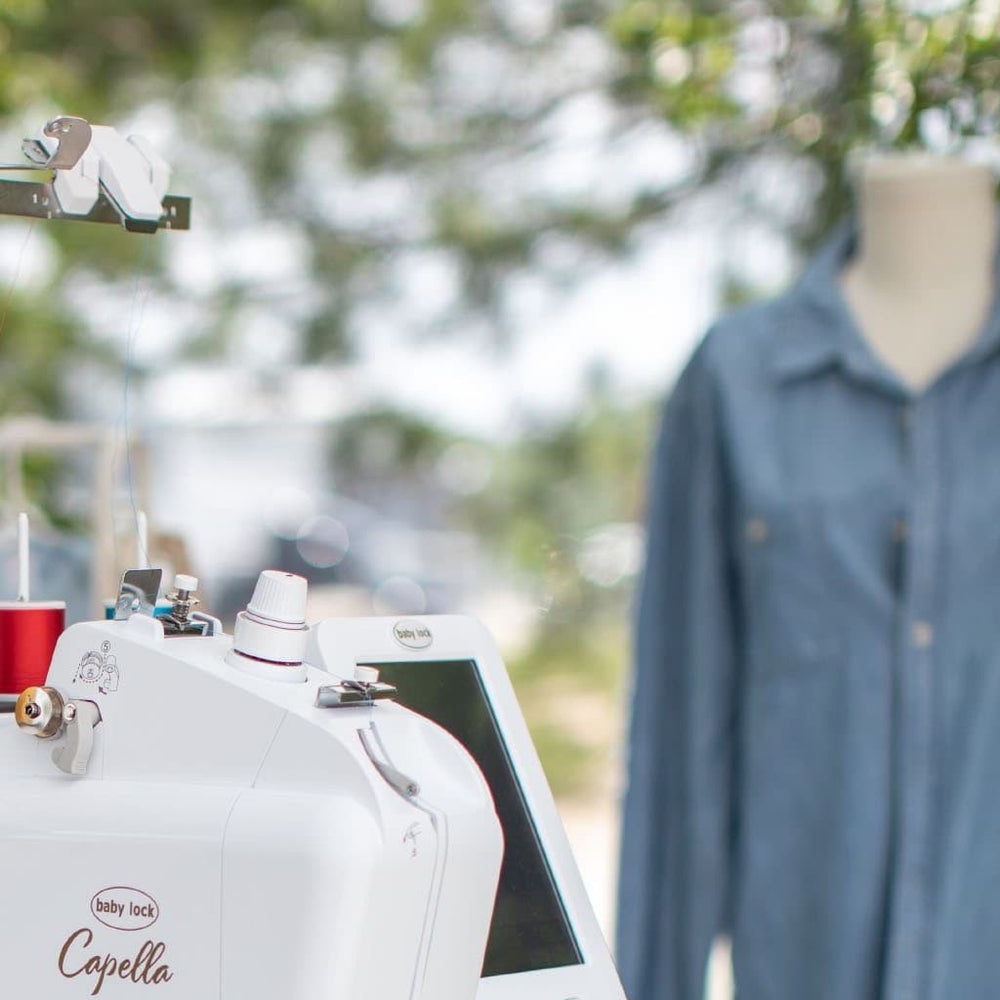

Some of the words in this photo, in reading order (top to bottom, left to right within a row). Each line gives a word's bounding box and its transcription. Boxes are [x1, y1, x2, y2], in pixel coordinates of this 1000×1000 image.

[96, 898, 125, 917] baby
[130, 902, 155, 918] lock
[58, 928, 174, 996] Capella
